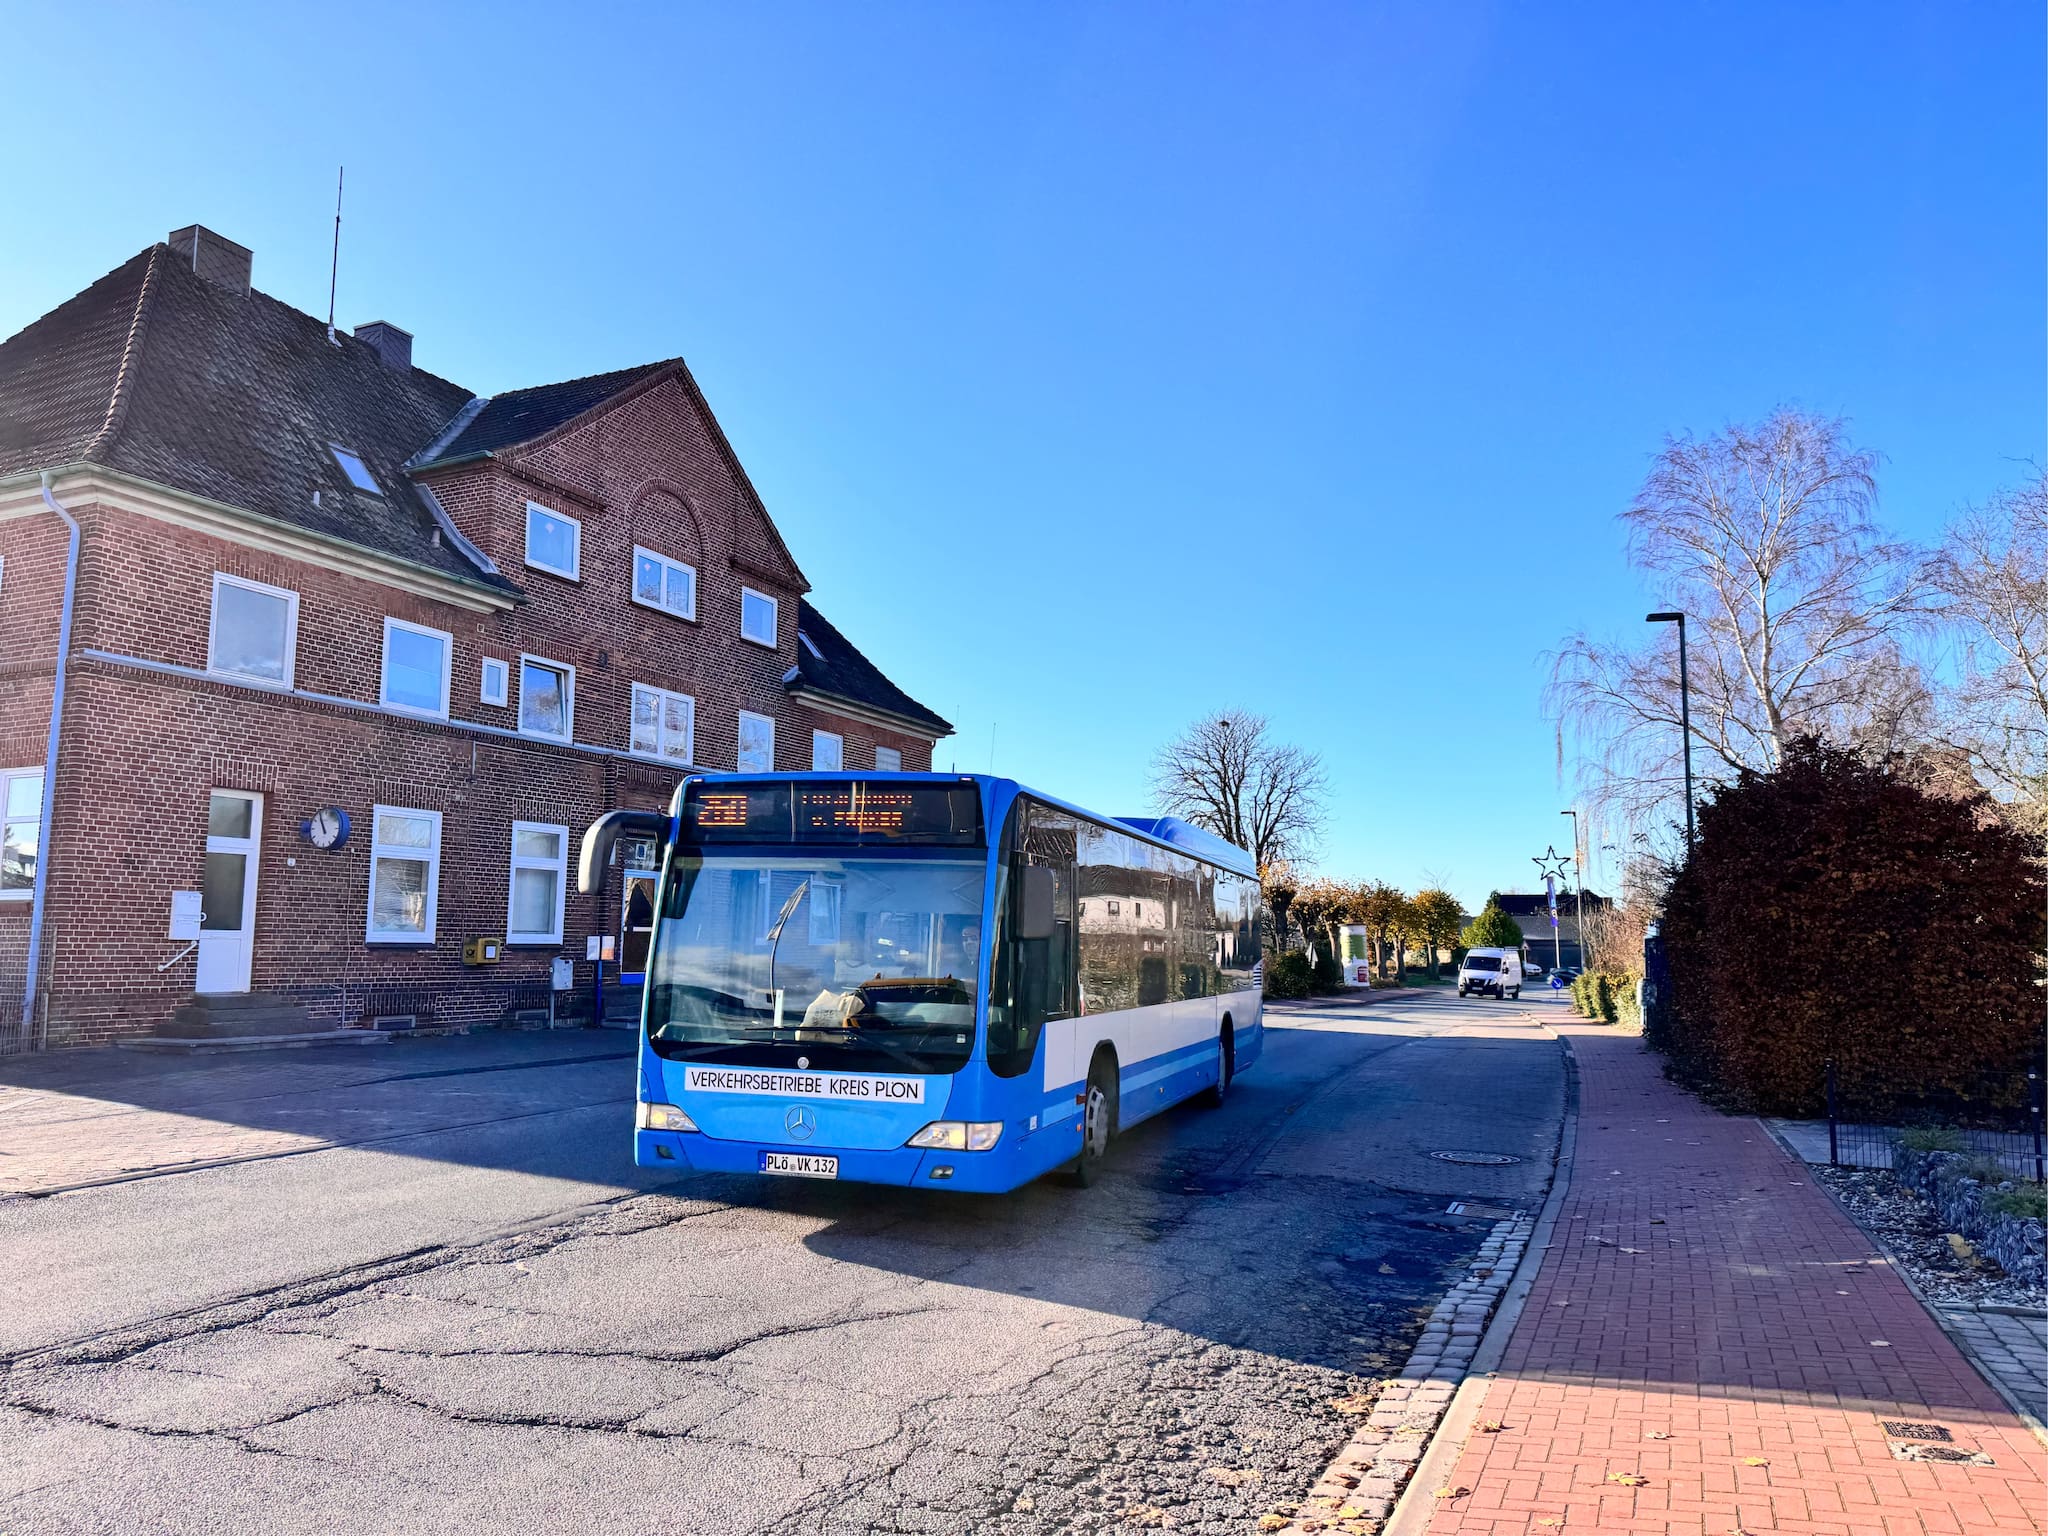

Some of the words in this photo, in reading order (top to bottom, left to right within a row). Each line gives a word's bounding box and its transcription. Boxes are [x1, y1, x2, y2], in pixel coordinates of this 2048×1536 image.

[691, 1071, 822, 1094] VERKEHRSBETRIEBE
[830, 1078, 869, 1096] KREIS
[875, 1080, 918, 1099] PLÖN
[767, 1155, 789, 1170] PLÖ
[797, 1157, 811, 1172] VK
[813, 1159, 835, 1174] 132
